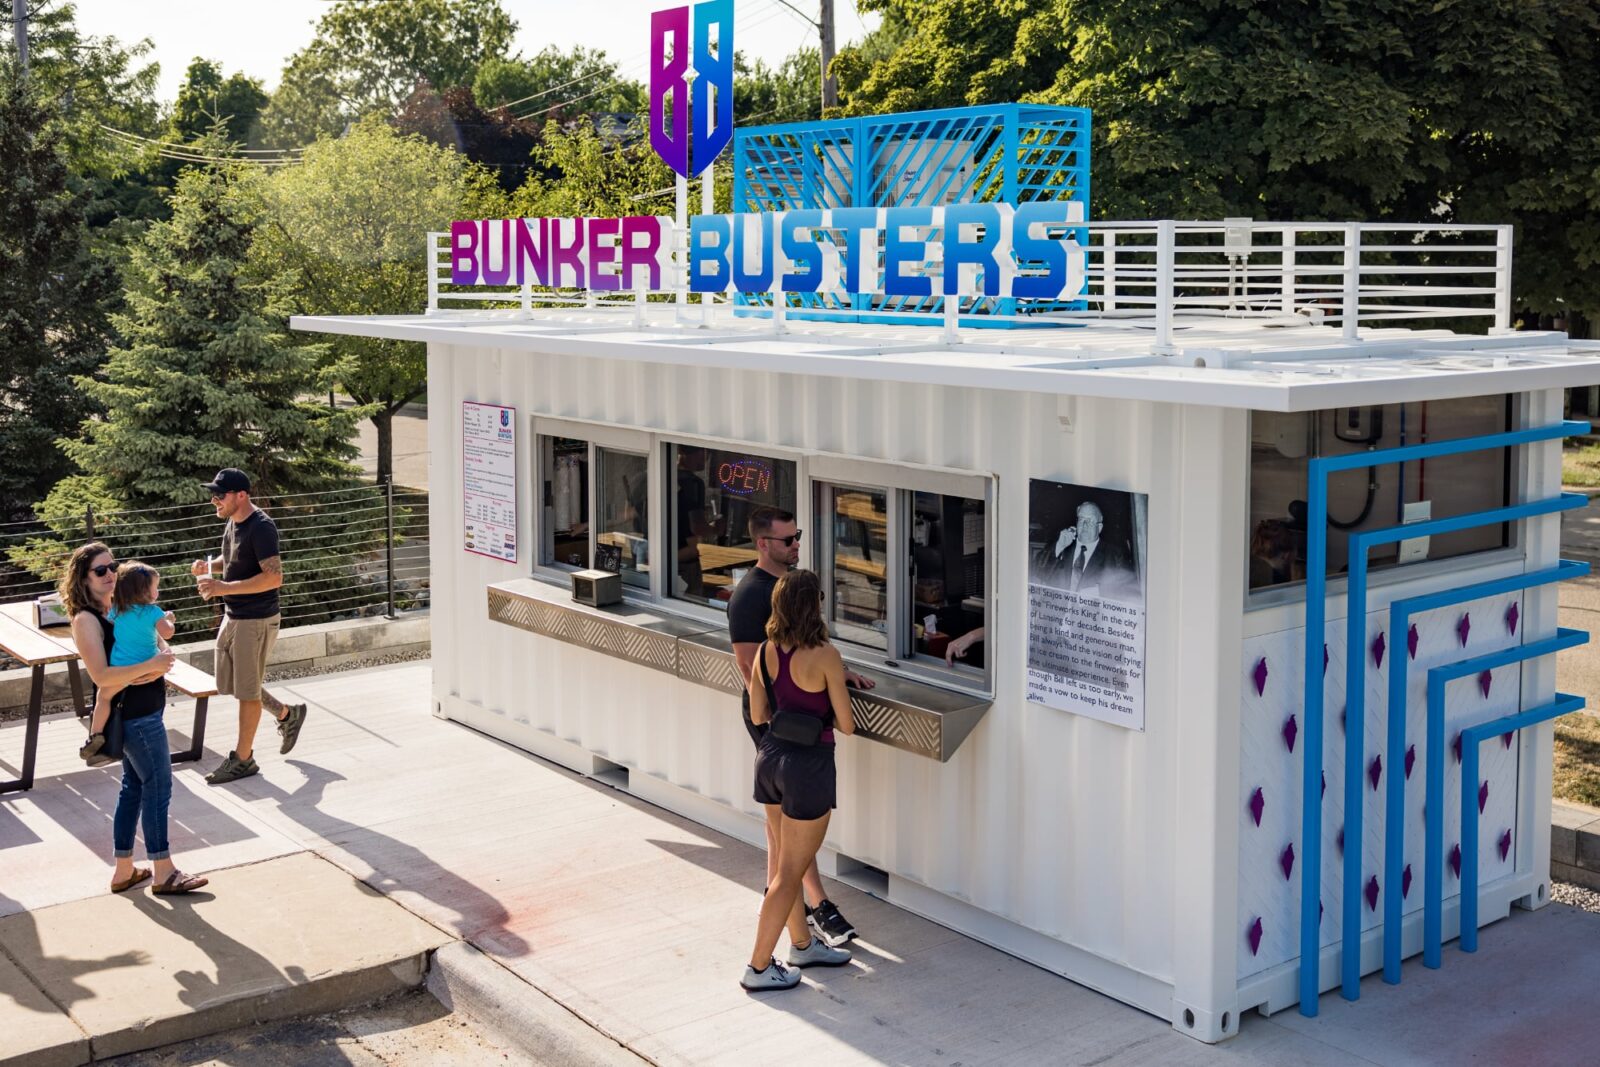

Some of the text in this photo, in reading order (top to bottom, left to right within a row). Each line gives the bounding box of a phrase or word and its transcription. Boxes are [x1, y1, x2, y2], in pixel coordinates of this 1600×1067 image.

[452, 201, 1073, 298] BUNKER BUSTERS
[718, 463, 770, 492] OPEN
[1030, 598, 1041, 607] the
[1081, 608, 1100, 622] King"
[1102, 613, 1108, 622] in
[1110, 616, 1122, 624] the
[1124, 619, 1137, 630] city
[1064, 595, 1077, 603] was
[1080, 596, 1100, 608] better
[1102, 601, 1127, 613] known
[1054, 626, 1070, 638] kind
[1071, 632, 1084, 640] and
[1085, 636, 1118, 648] generous
[1064, 617, 1075, 626] for
[1077, 620, 1106, 634] decades.
[1108, 627, 1134, 640] Besides
[1030, 632, 1141, 668] Bill always had the vision of tying
[1048, 651, 1070, 662] cream
[1080, 658, 1092, 667] the
[1094, 660, 1128, 676] fireworks
[1130, 668, 1141, 679] for
[1029, 656, 1129, 688] the ultimate experience. Even
[1029, 669, 1052, 682] though
[1054, 674, 1064, 684] Bill
[1066, 677, 1078, 688] left
[1088, 686, 1102, 694] too
[1104, 689, 1122, 700] early,
[1122, 694, 1134, 702] we
[1028, 692, 1046, 703] alive.
[1028, 682, 1047, 692] made
[1054, 688, 1068, 696] vow
[1080, 692, 1096, 706] keep
[1098, 698, 1108, 708] his
[1110, 702, 1132, 714] dream
